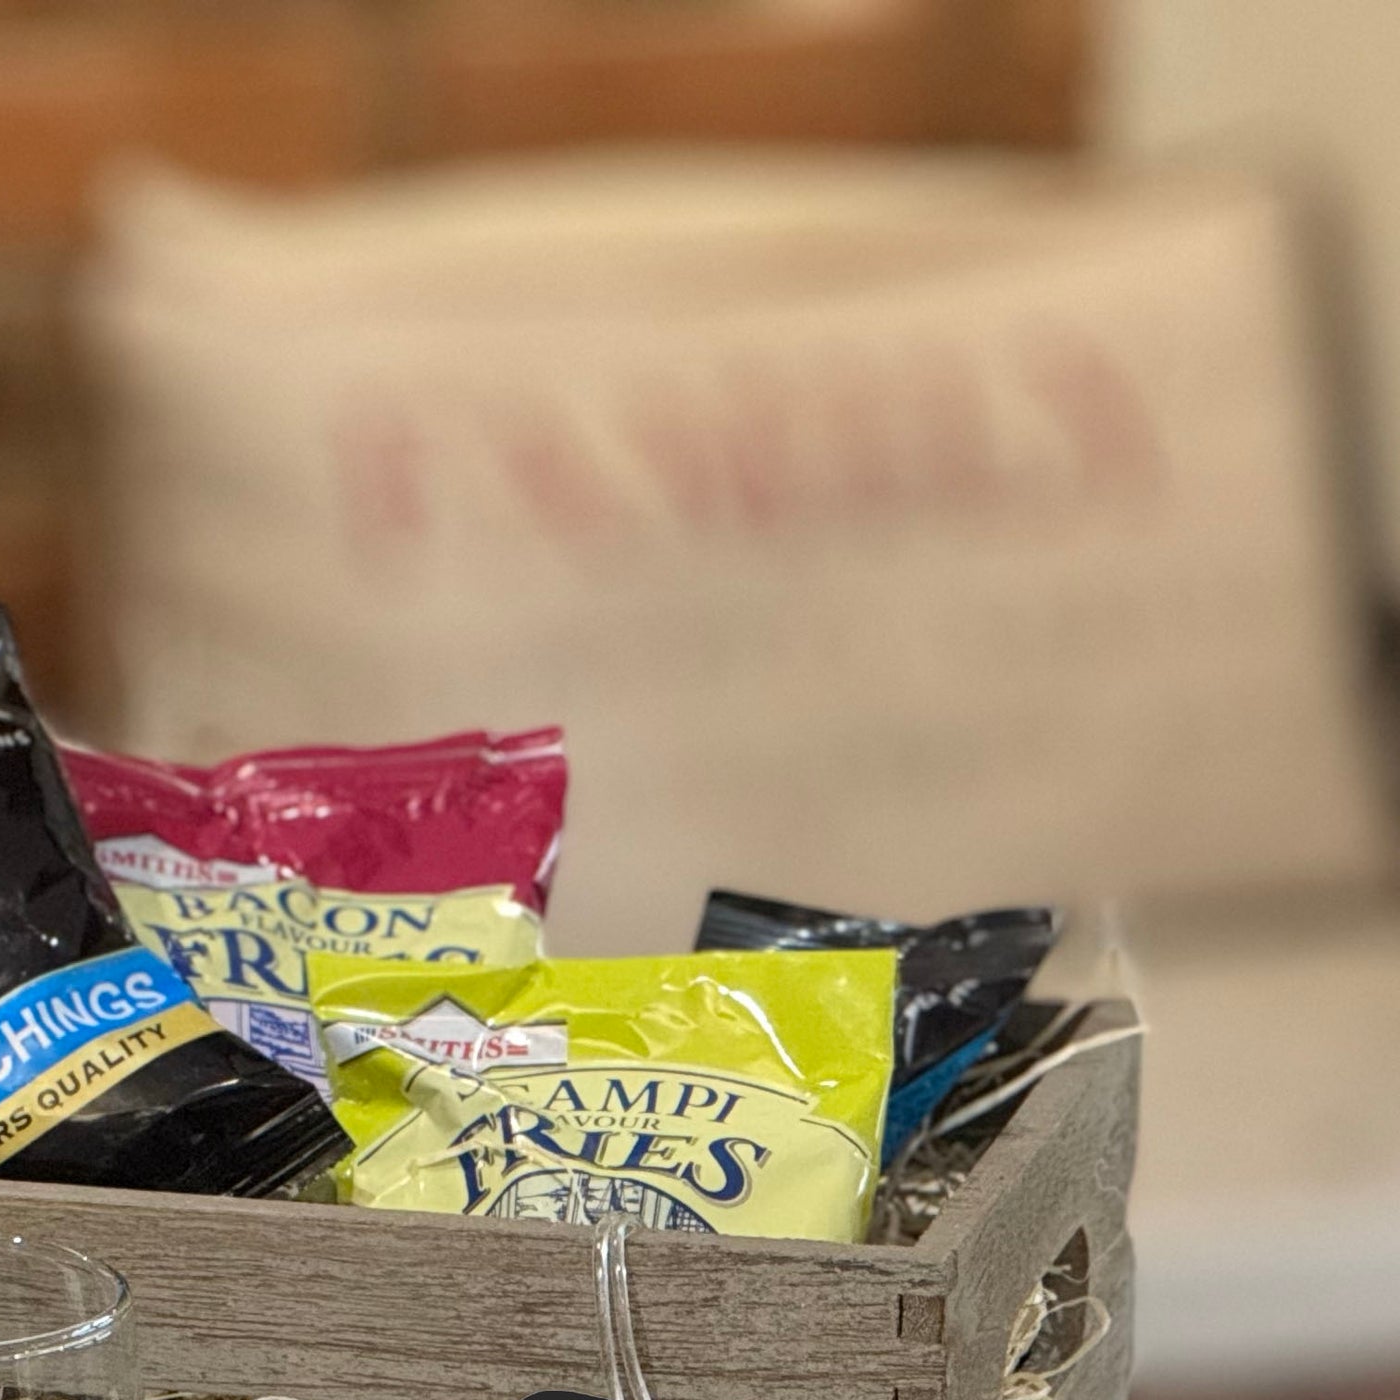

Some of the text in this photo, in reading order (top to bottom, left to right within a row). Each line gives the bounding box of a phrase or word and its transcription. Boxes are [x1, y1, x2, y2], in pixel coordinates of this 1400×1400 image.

[239, 911, 374, 956] FLAVOUR
[36, 1022, 167, 1112] QUALITY
[448, 1104, 772, 1217] FRIES
